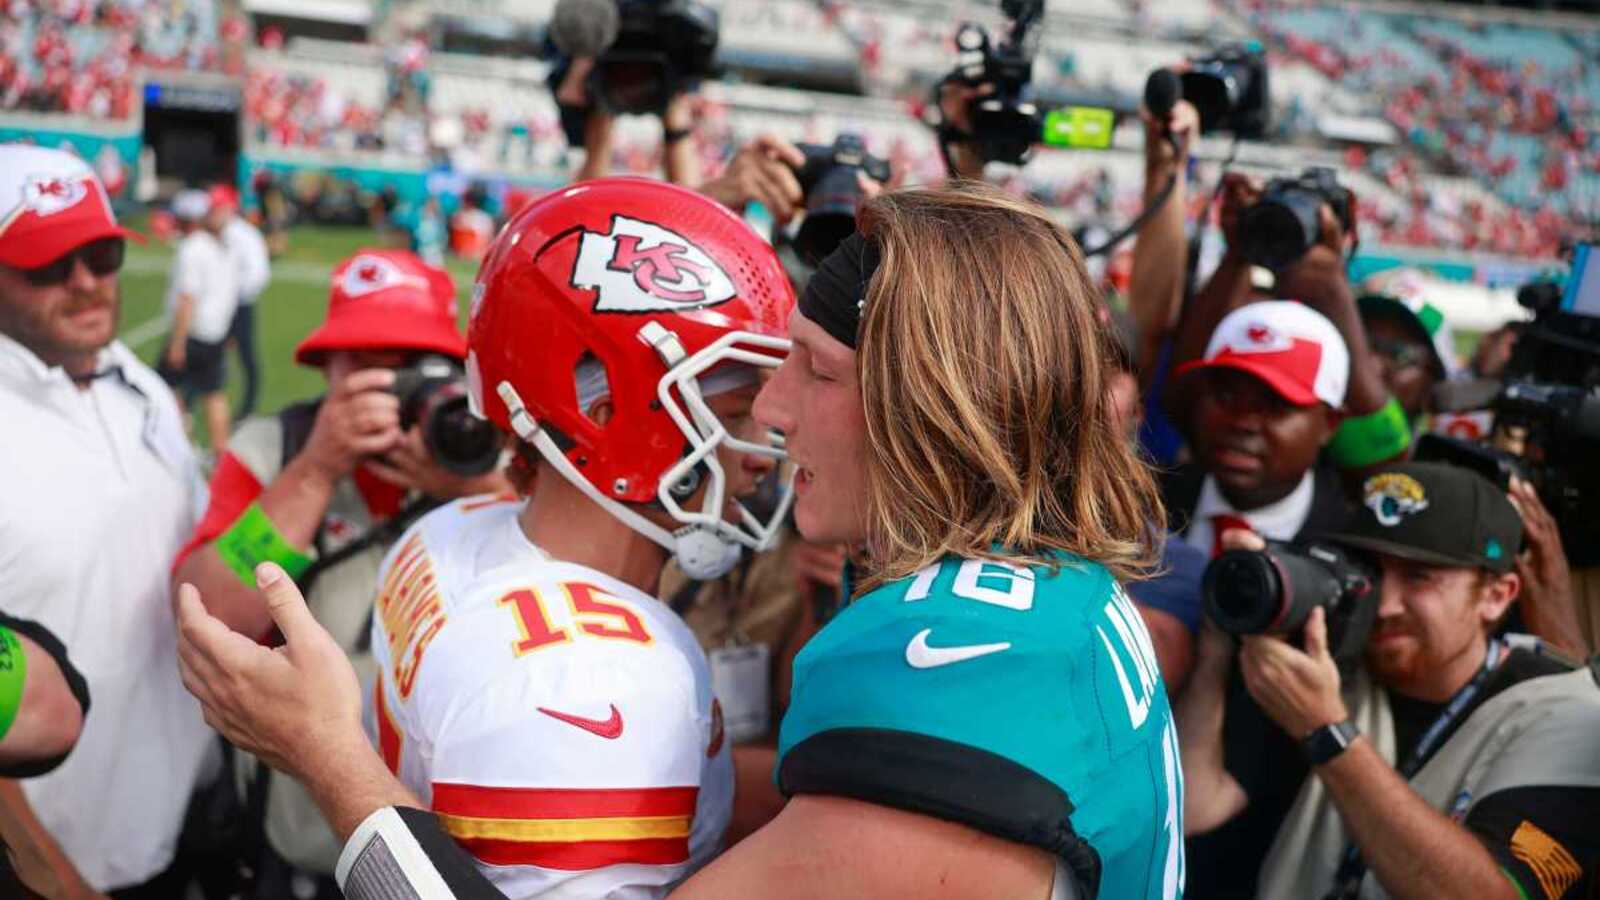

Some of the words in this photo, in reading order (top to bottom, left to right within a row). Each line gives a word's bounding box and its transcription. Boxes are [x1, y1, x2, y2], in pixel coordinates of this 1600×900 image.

[606, 234, 712, 303] KC
[497, 581, 655, 657] 15
[904, 558, 1036, 612] 16
